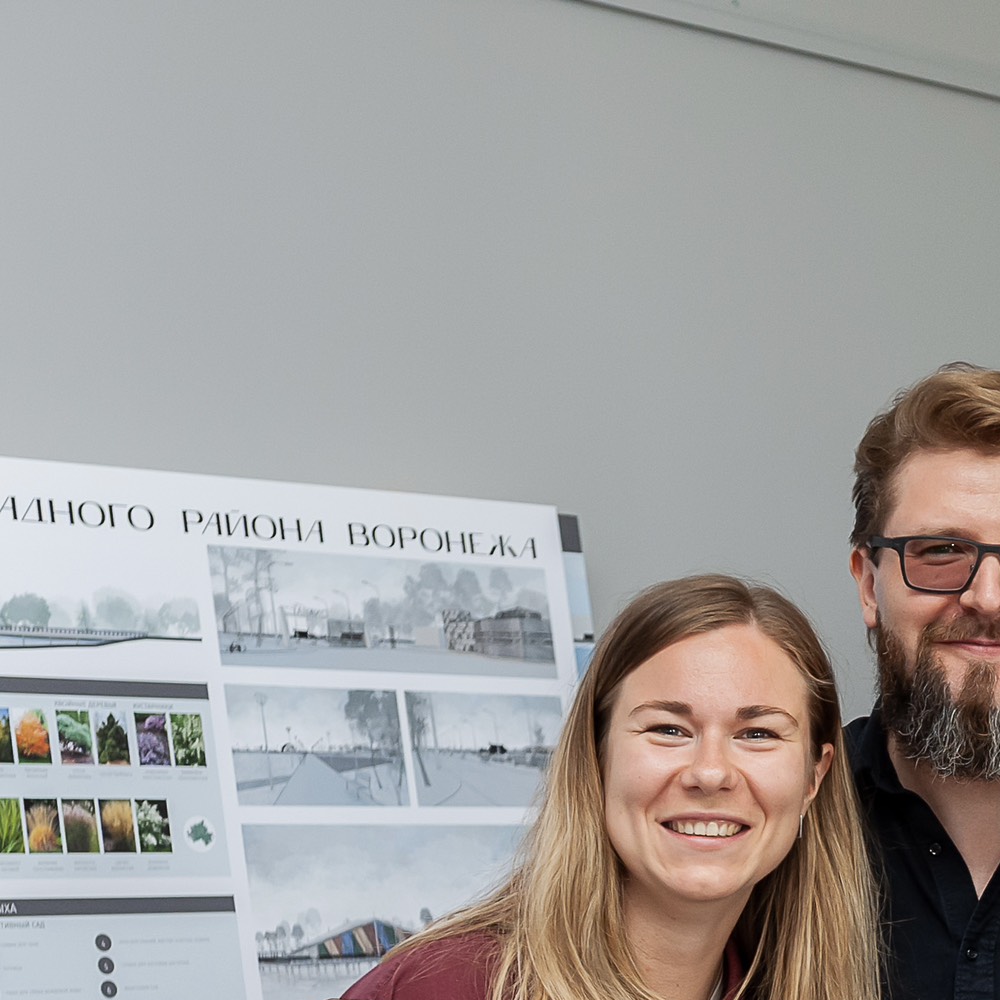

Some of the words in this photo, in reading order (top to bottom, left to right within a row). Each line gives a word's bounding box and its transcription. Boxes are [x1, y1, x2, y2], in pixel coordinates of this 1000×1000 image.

[0, 496, 154, 532] АДНОГО
[181, 508, 324, 543] РАЙОНА
[348, 522, 537, 559] ВОРОНЕЖА
